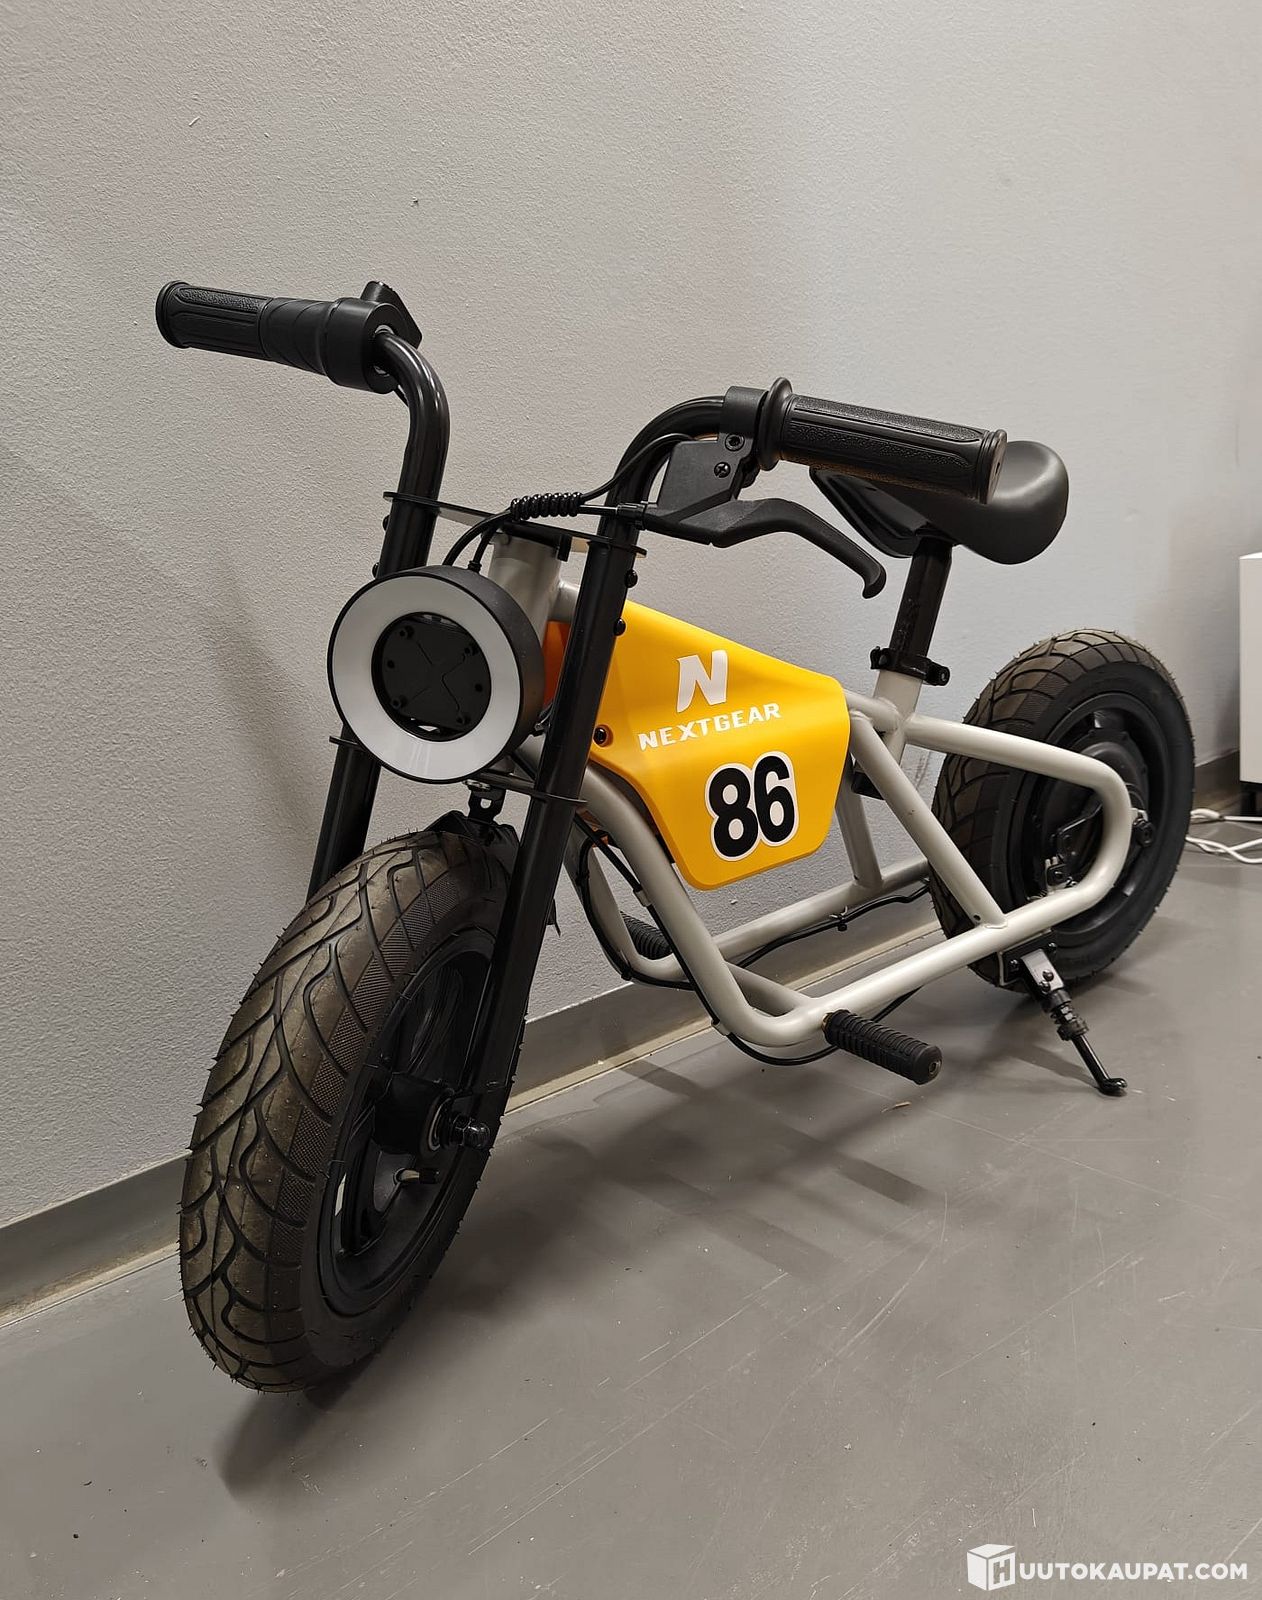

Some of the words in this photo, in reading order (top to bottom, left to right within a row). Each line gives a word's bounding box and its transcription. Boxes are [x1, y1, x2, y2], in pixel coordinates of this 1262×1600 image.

[677, 649, 728, 713] N
[637, 702, 782, 750] NEXTGEAR
[706, 752, 798, 860] 86
